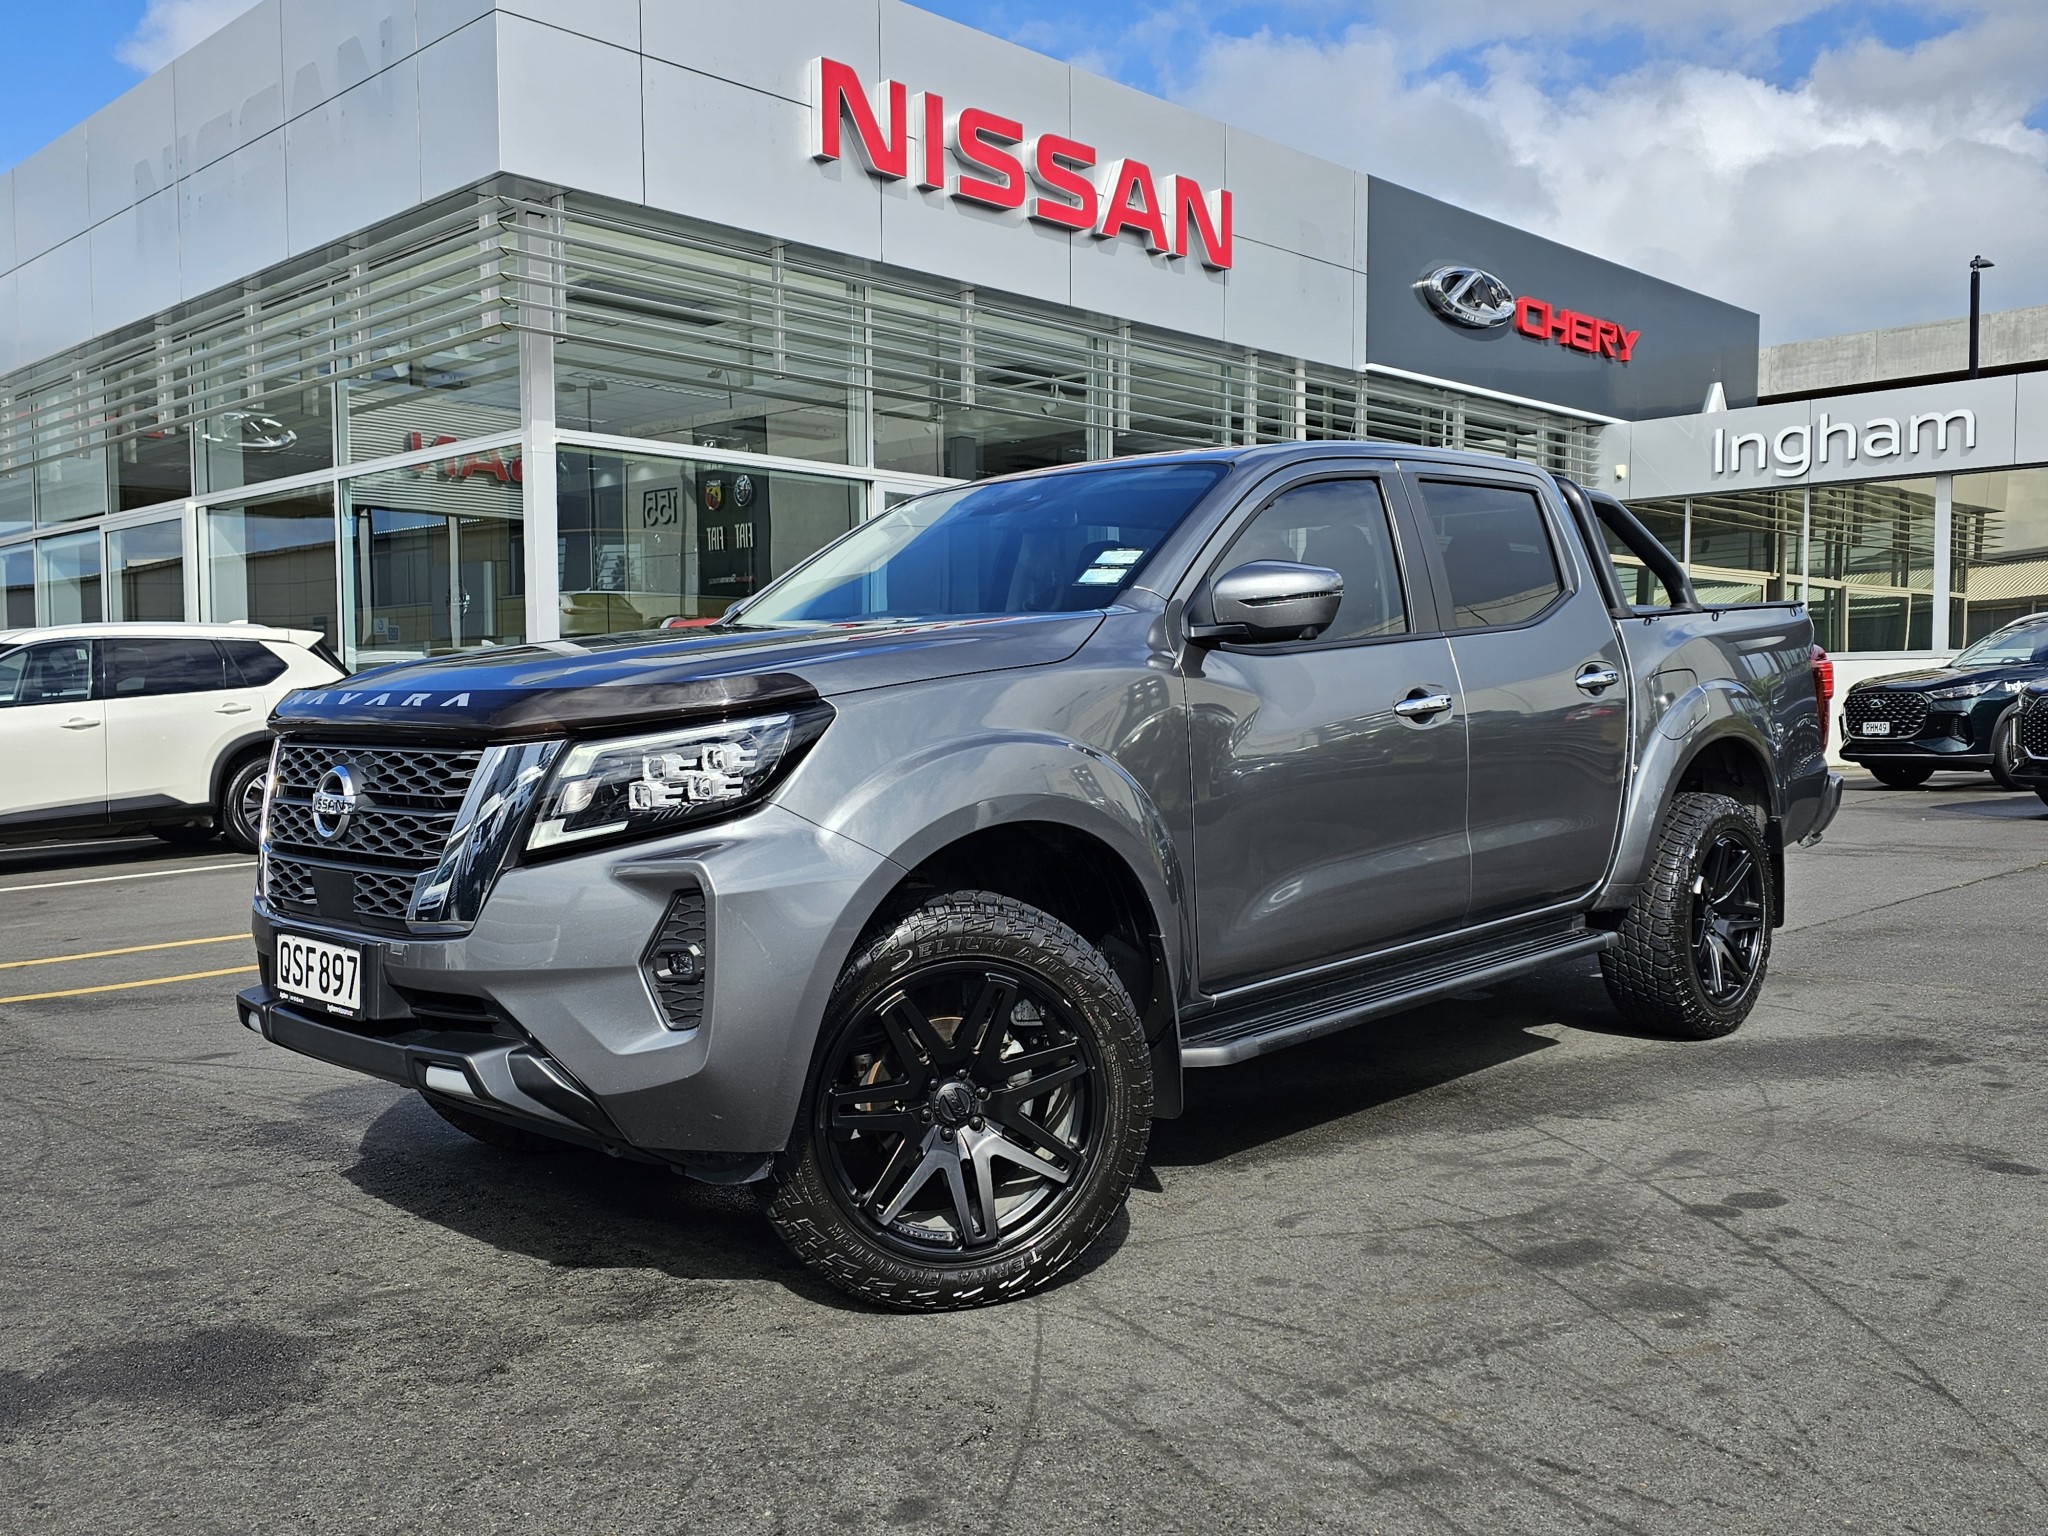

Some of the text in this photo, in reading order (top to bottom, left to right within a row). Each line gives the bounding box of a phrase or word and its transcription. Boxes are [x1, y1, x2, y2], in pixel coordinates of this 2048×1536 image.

[811, 56, 1233, 270] NISSAN
[1514, 296, 1641, 362] CHERY
[1714, 408, 1976, 477] Ingham
[288, 692, 471, 707] NAVARA
[280, 941, 358, 1000] QSF897
[959, 1247, 1043, 1287] TERRA
